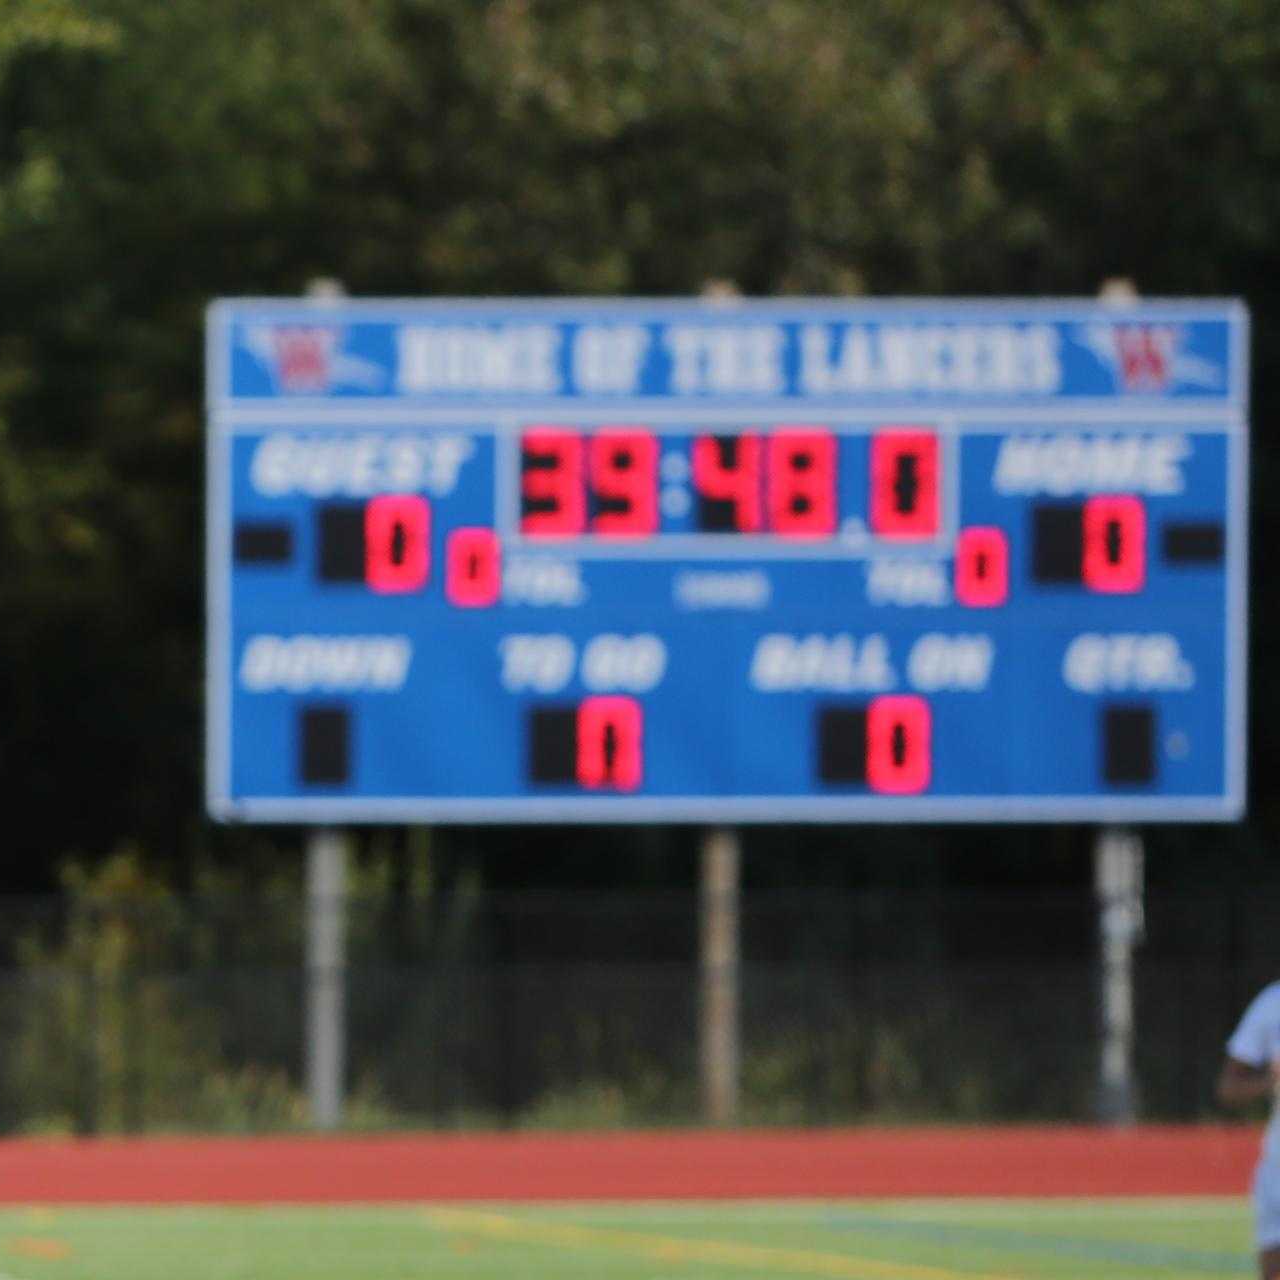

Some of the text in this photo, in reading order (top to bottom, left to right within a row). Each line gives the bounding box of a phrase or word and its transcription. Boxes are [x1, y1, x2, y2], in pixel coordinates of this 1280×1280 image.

[397, 323, 1063, 394] HOME OF THE LANCERS
[251, 430, 476, 498] GUEST
[990, 436, 1193, 497] HOME
[363, 493, 433, 596] 0
[1081, 493, 1147, 596] 0
[241, 634, 412, 695] DOWN
[498, 634, 668, 695] TO GO
[750, 633, 996, 694] BALL ON
[865, 694, 934, 796] 0
